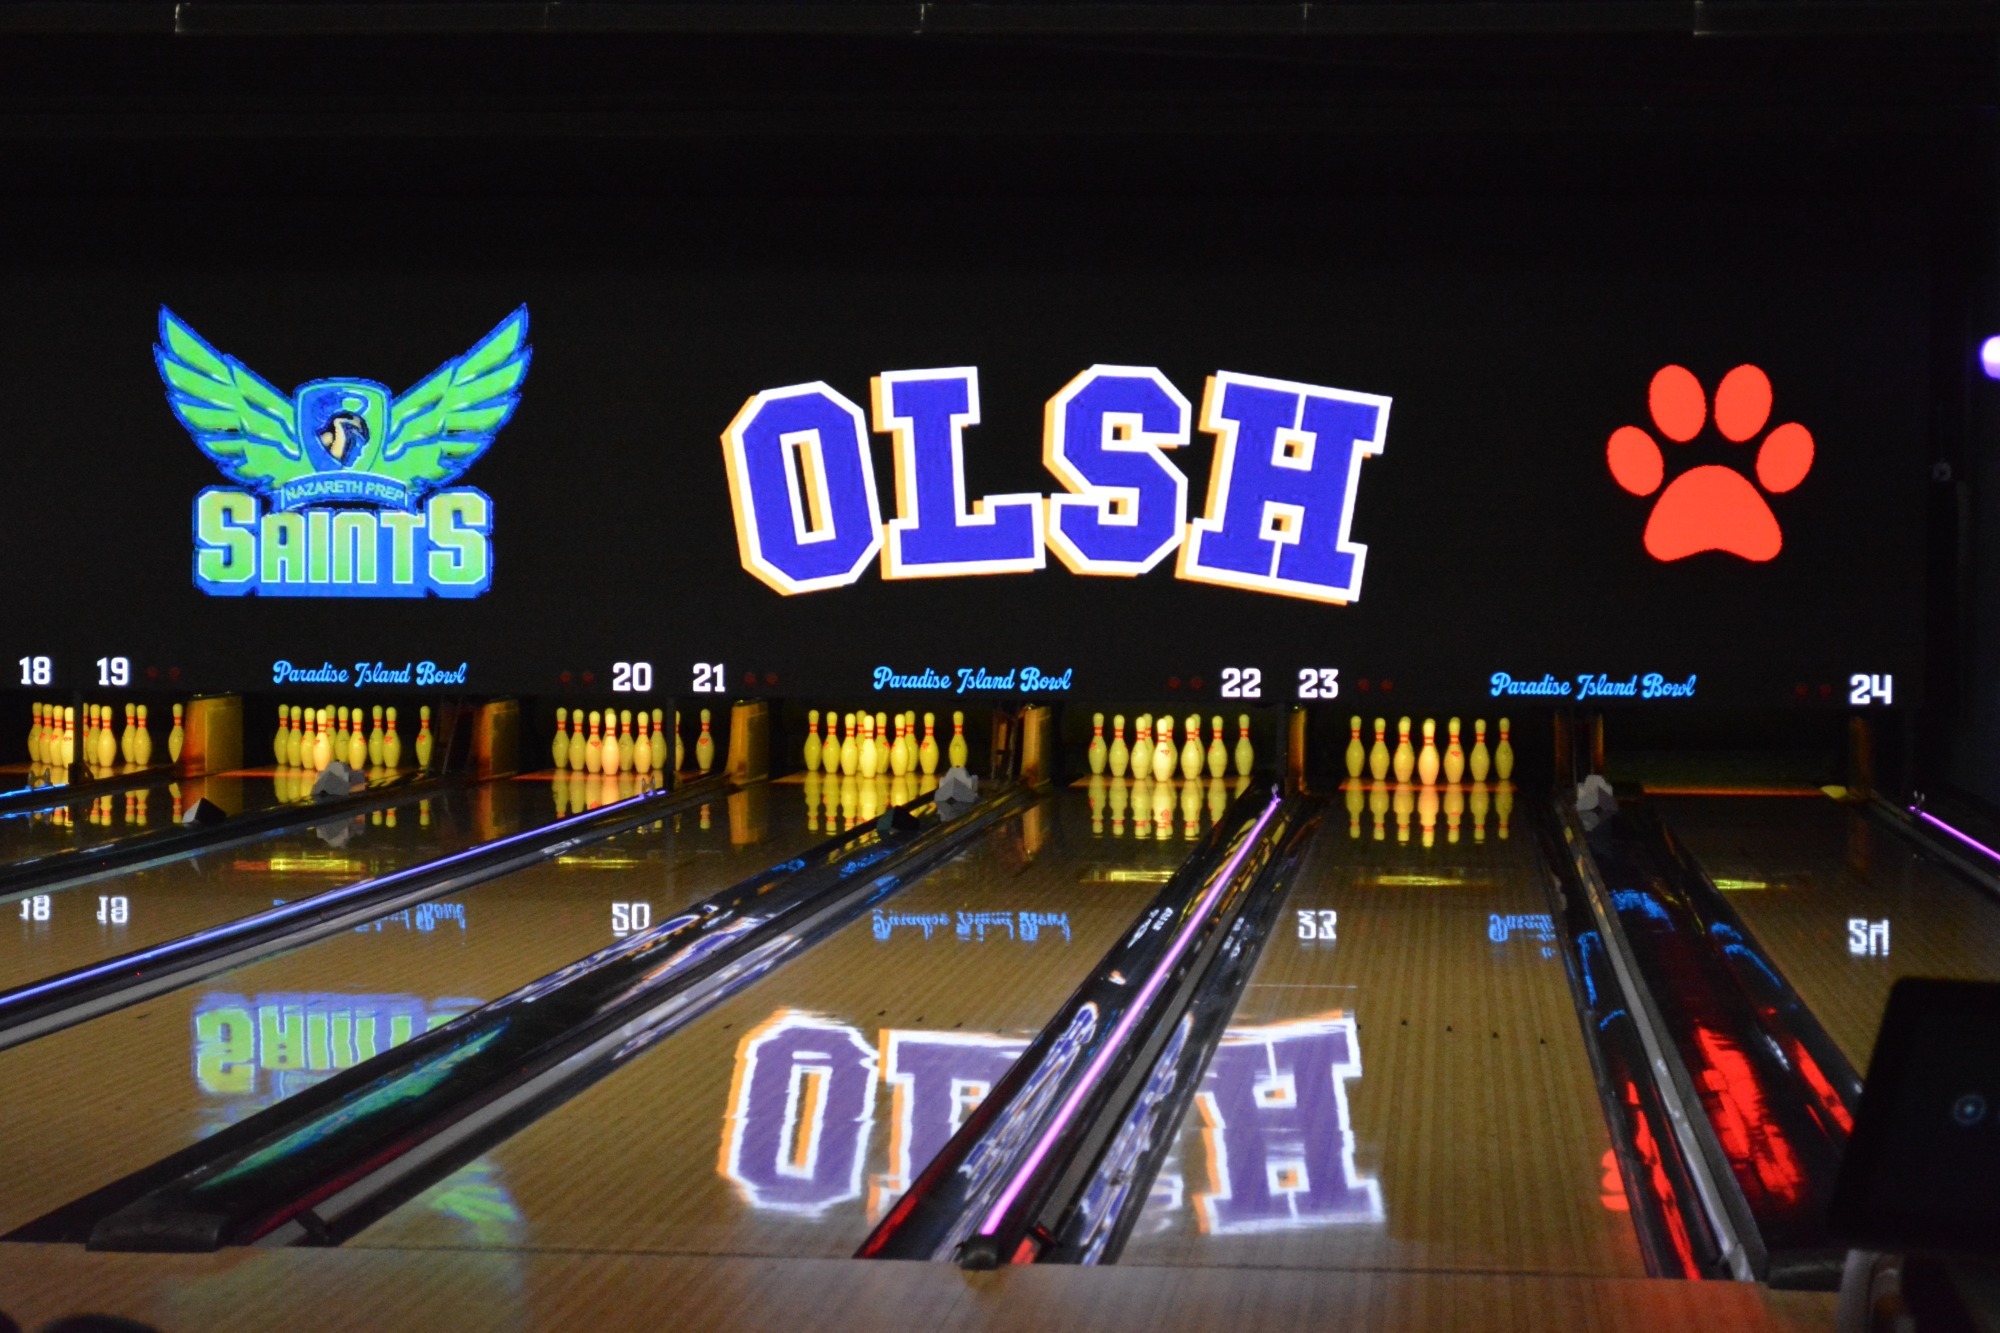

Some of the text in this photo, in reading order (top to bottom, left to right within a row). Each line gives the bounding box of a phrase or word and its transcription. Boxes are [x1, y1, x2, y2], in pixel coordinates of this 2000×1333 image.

[285, 480, 405, 501] NAZARETH PREP
[720, 364, 1393, 606] OLSH
[193, 485, 494, 599] SAINTS
[19, 656, 52, 686] 18
[97, 657, 130, 686] 19
[273, 660, 467, 688] Paradise Island Bowl
[612, 662, 653, 692] 20
[692, 663, 726, 692] 21
[873, 665, 1073, 694] Paradise Island Bowl
[1221, 668, 1262, 698] 22
[1298, 668, 1339, 698] 23
[1490, 671, 1697, 701] Paradise Island Bowl
[1849, 673, 1893, 705] 24
